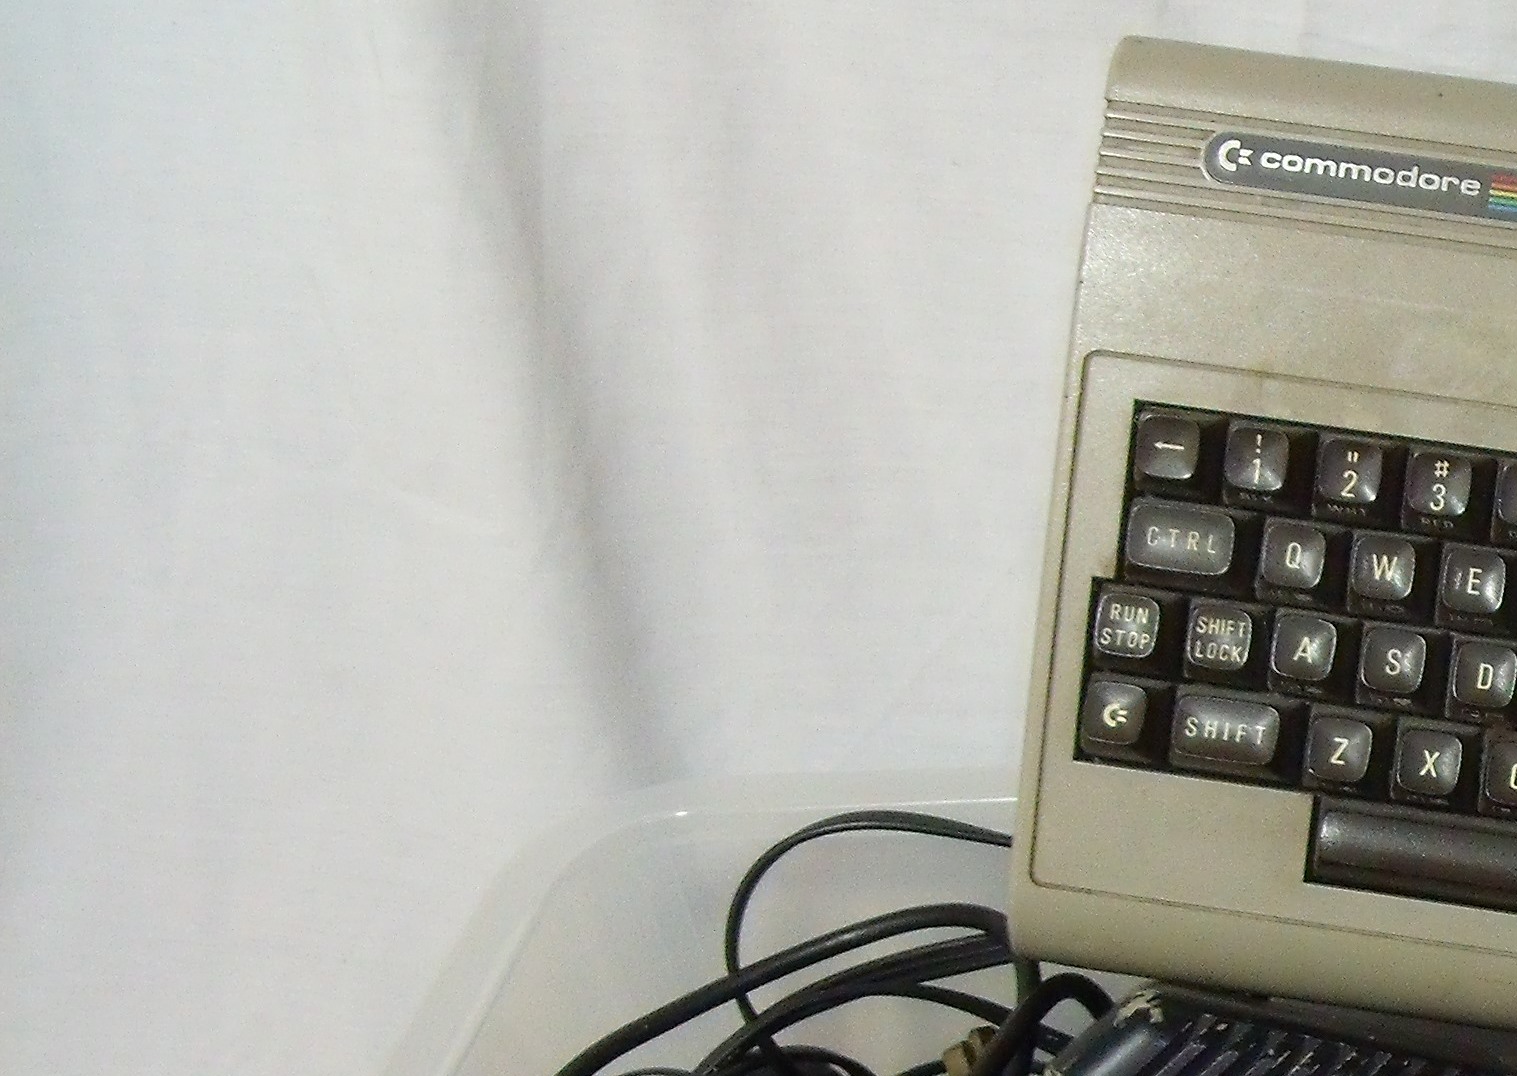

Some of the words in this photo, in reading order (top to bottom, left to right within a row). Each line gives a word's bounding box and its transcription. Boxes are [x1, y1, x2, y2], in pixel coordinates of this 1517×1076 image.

[1260, 150, 1481, 197] commodore
[1252, 458, 1262, 484] 1
[1341, 470, 1359, 498] 2
[1430, 483, 1447, 511] 3
[1147, 526, 1216, 554] CTRL
[1285, 541, 1302, 570] Q
[1371, 554, 1395, 582] W
[1466, 568, 1484, 597] E
[1110, 603, 1149, 624] RUN
[1196, 617, 1247, 638] SHIFT
[1100, 628, 1150, 650] STOP
[1195, 639, 1243, 663] LOCK
[1292, 636, 1313, 664] A
[1385, 649, 1402, 676] S
[1477, 662, 1494, 691] D
[1184, 716, 1269, 746] SHIFT
[1330, 737, 1349, 767] Z
[1419, 748, 1439, 778] X
